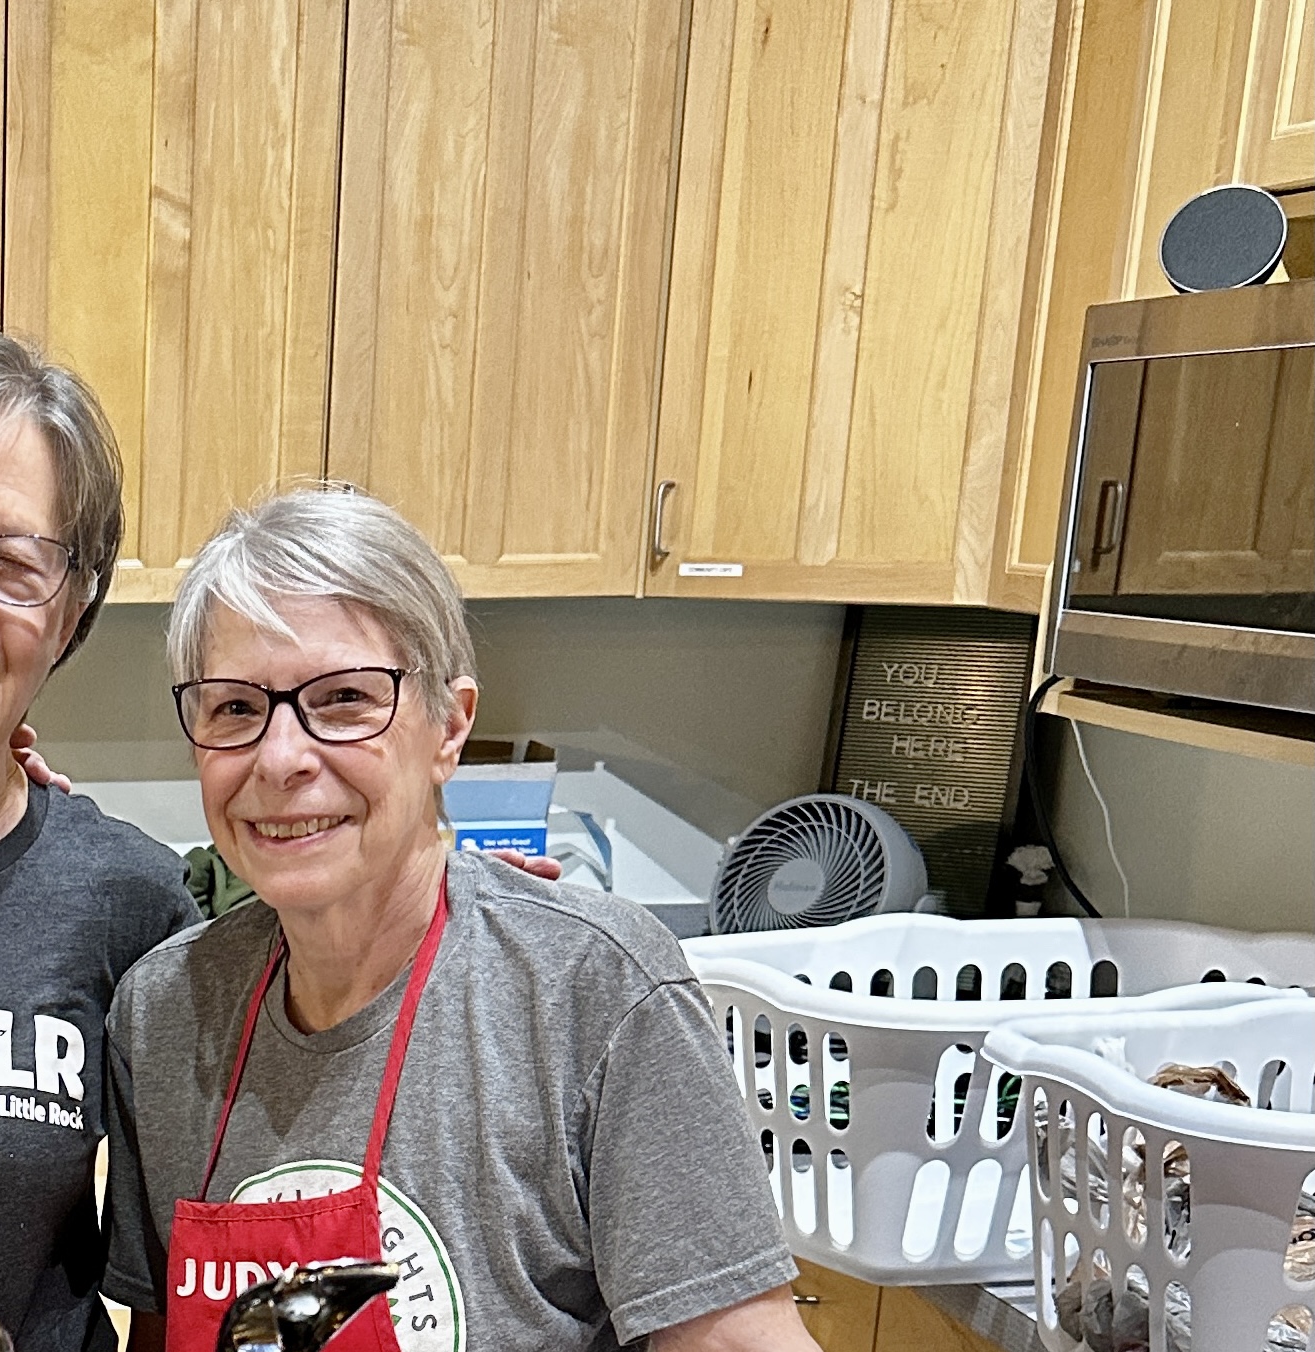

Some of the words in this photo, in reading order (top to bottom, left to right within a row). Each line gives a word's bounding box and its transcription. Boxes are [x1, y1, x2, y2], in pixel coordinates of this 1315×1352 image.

[881, 663, 938, 687] YOU
[862, 699, 979, 726] BELONG
[891, 734, 965, 761] HERE
[849, 779, 898, 803] THE
[0, 1095, 46, 1123] Little
[48, 1105, 85, 1131] Rock
